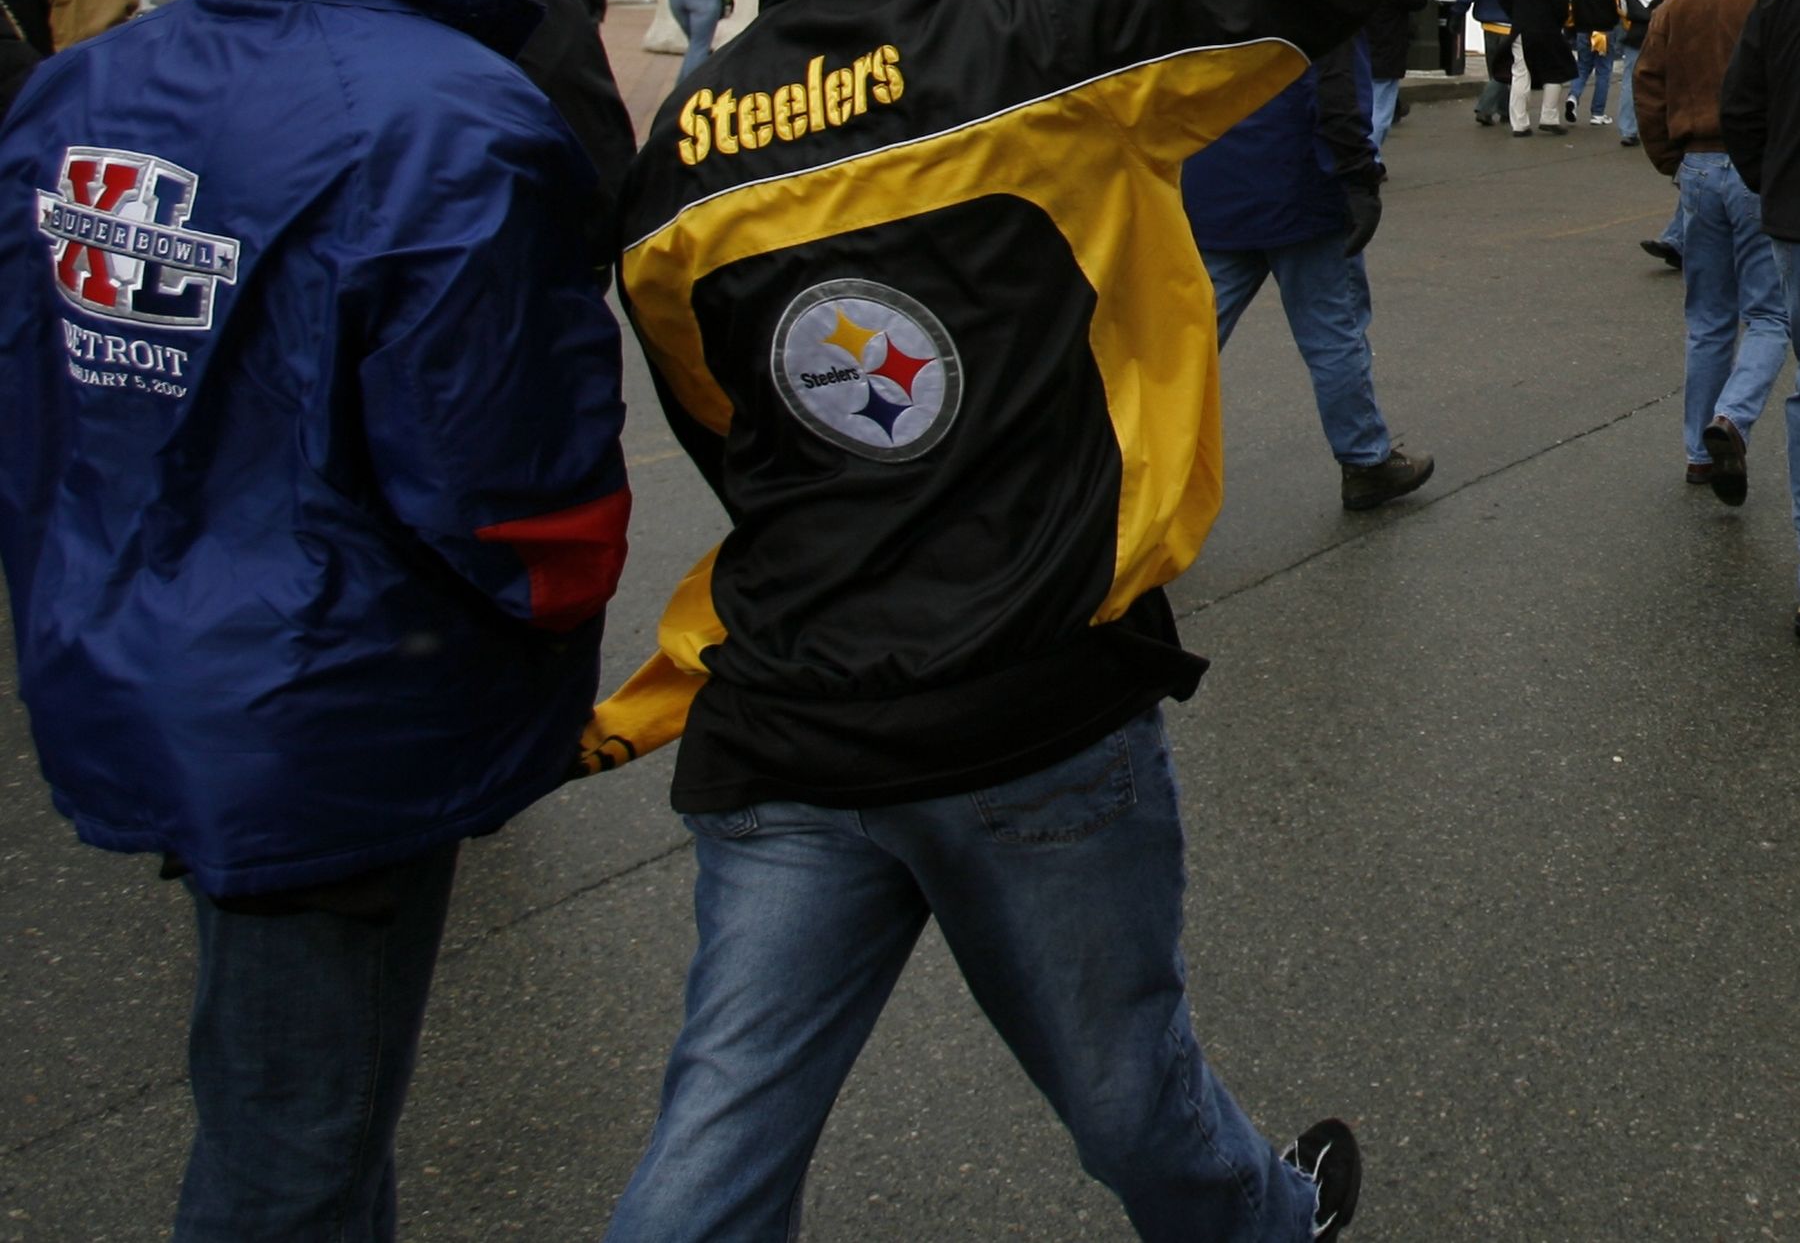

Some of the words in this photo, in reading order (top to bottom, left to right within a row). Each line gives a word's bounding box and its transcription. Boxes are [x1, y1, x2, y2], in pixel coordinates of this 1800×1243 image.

[678, 44, 905, 166] Steelers
[52, 208, 129, 245] SUPER
[135, 237, 212, 264] BOWL
[57, 159, 202, 319] XL
[61, 317, 188, 377] DETROIT
[800, 364, 861, 390] Steelers
